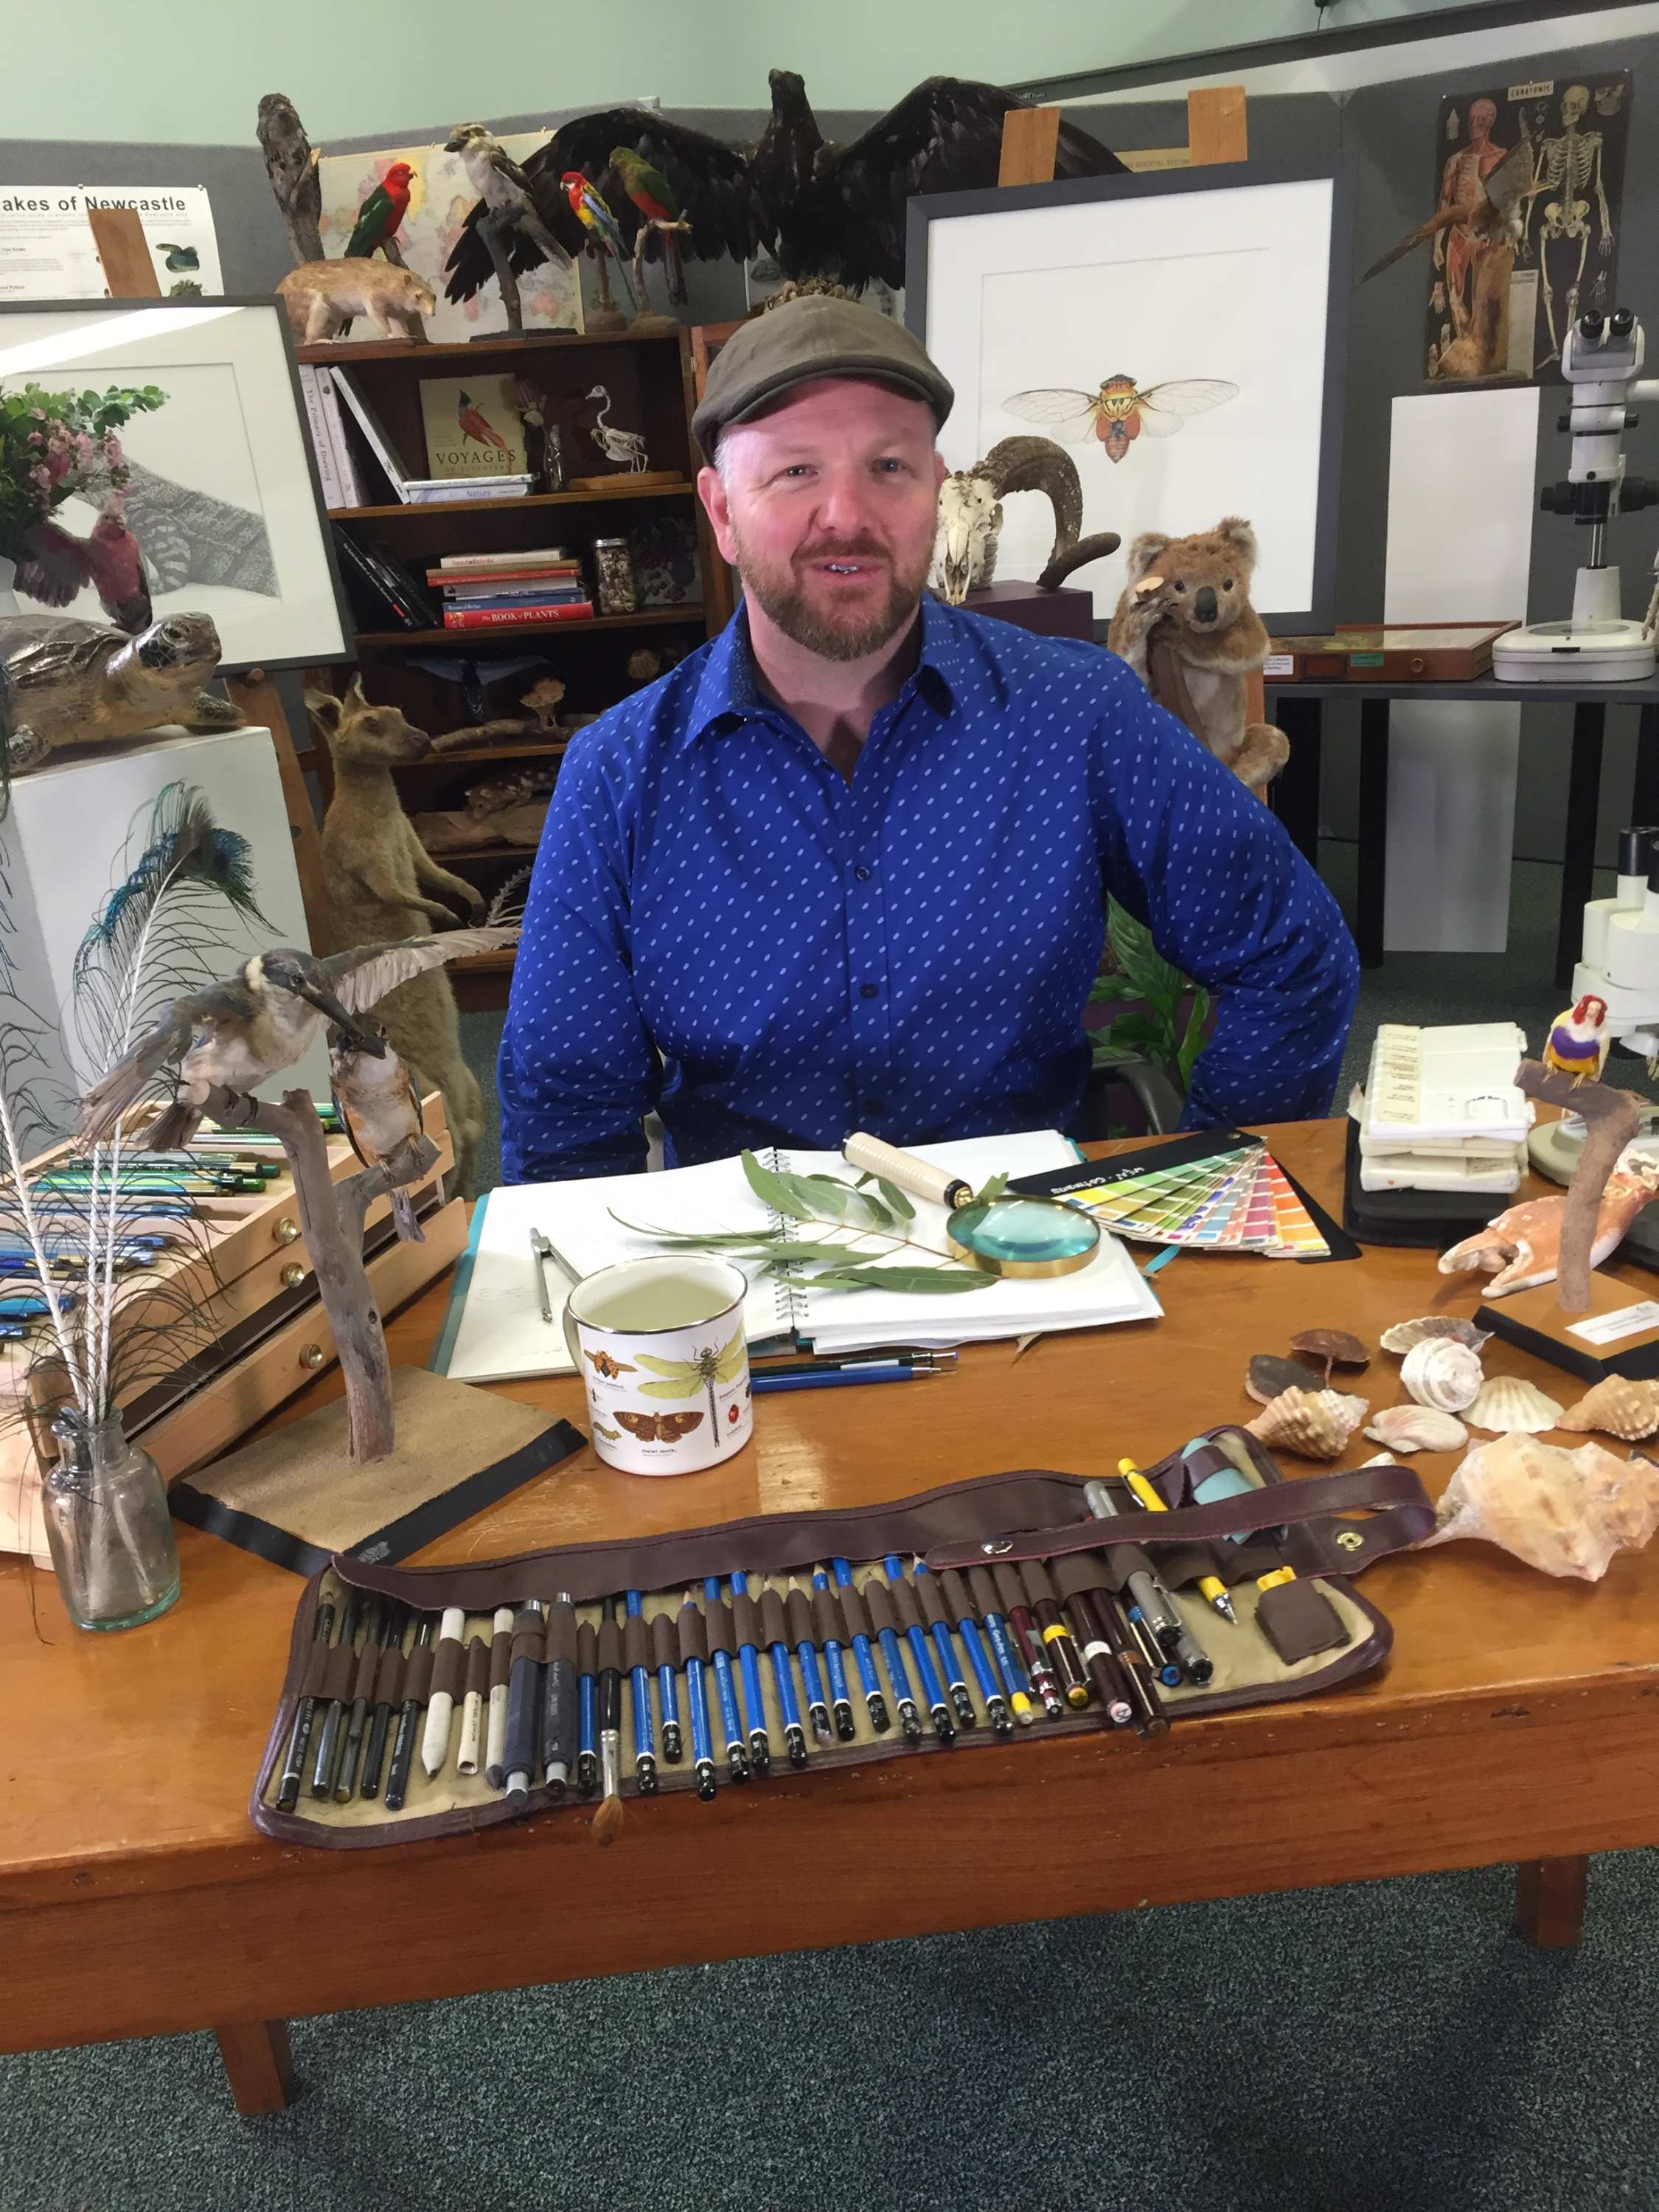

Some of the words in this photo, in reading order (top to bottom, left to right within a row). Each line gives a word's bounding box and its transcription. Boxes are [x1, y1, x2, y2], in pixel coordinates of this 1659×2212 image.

[2, 197, 49, 211] akes
[58, 197, 77, 211] of
[85, 197, 186, 211] Newcastle
[436, 449, 517, 465] VOYAGES
[320, 451, 332, 482] Drawing
[466, 490, 492, 498] Nature
[491, 612, 518, 622] BOOK
[524, 609, 560, 620] PLANTS
